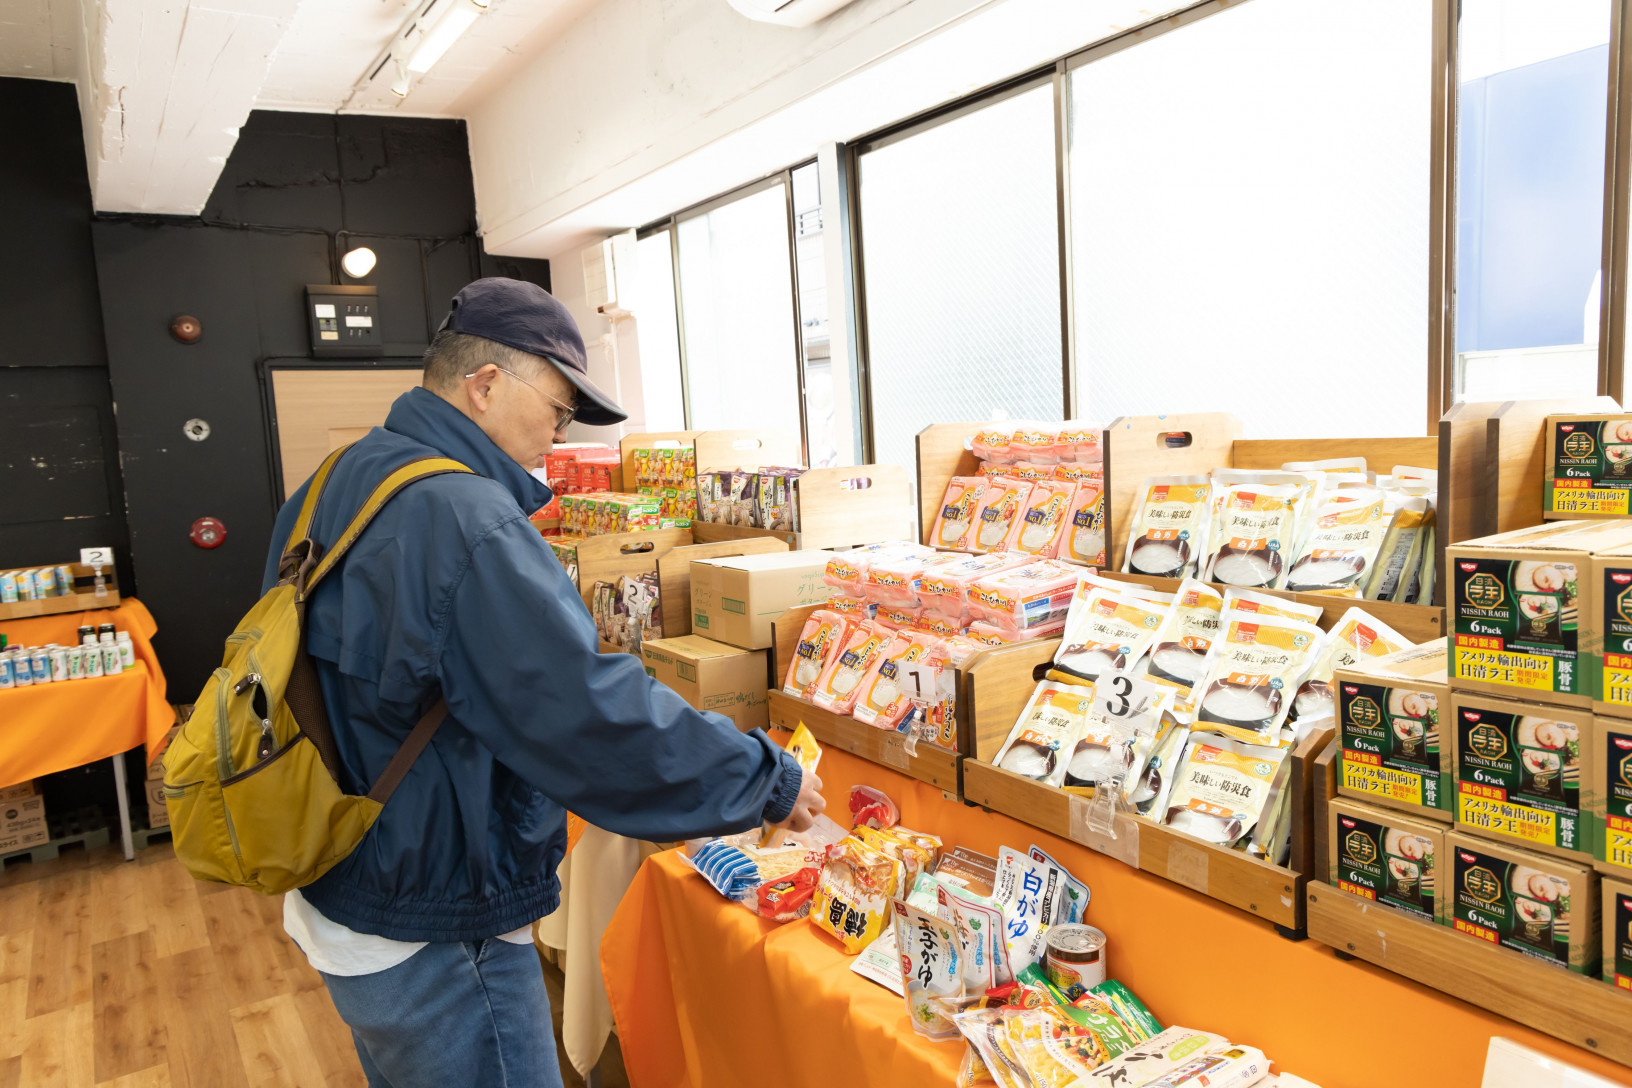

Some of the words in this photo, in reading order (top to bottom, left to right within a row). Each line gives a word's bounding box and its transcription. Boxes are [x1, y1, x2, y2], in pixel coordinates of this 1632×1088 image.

[1567, 468, 1574, 476] 6
[1558, 491, 1625, 500] アメリカ輸出向け
[1148, 509, 1192, 519] 美味しい防災食
[1558, 501, 1599, 511] 日清ラ王
[89, 552, 104, 562] 2
[981, 592, 1008, 608] こしひかり
[1470, 585, 1499, 600] ラ王
[1461, 608, 1486, 616] NISSIN
[1488, 610, 1509, 618] RAOH
[1470, 620, 1480, 632] 6
[1482, 626, 1502, 634] Pack
[1458, 636, 1499, 648] 国内製造
[1461, 651, 1549, 670] アメリカ輸出向け
[1461, 664, 1514, 682] 日清ラ王
[1558, 660, 1572, 685] 豚骨
[909, 671, 920, 697] 1
[1106, 676, 1132, 716] 3
[1352, 706, 1377, 720] ラ王
[1346, 726, 1366, 735] NISSIN
[1354, 738, 1362, 748] 6
[1364, 743, 1380, 752] Pack
[1472, 735, 1503, 750] ラ王
[1345, 751, 1378, 764] 国内製造
[1464, 756, 1490, 767] NISSIN
[1492, 760, 1512, 770] RAOH
[1347, 764, 1418, 787] アメリカ輸出向け
[1474, 770, 1484, 780] 6
[1485, 776, 1504, 786] Pack
[1190, 771, 1252, 798] 美味しい防災食
[1348, 776, 1392, 794] 日清ラ王
[1425, 779, 1436, 801] 豚骨
[1462, 783, 1502, 799] 国内製造
[1464, 798, 1551, 826] アメリカ輸出向け
[1465, 811, 1518, 834] 日清ラ王
[1560, 818, 1575, 842] 豚骨
[1350, 871, 1358, 882] 6
[1358, 877, 1374, 888] Pack
[1468, 876, 1497, 895] ラ王
[1008, 867, 1042, 939] 白がゆ
[1460, 894, 1484, 908] NISSIN
[830, 897, 867, 938] 徳島
[1468, 910, 1477, 921] 6
[1478, 916, 1498, 929] Pack
[1456, 921, 1494, 942] 国内製造
[917, 916, 938, 988] 玉子がゆ
